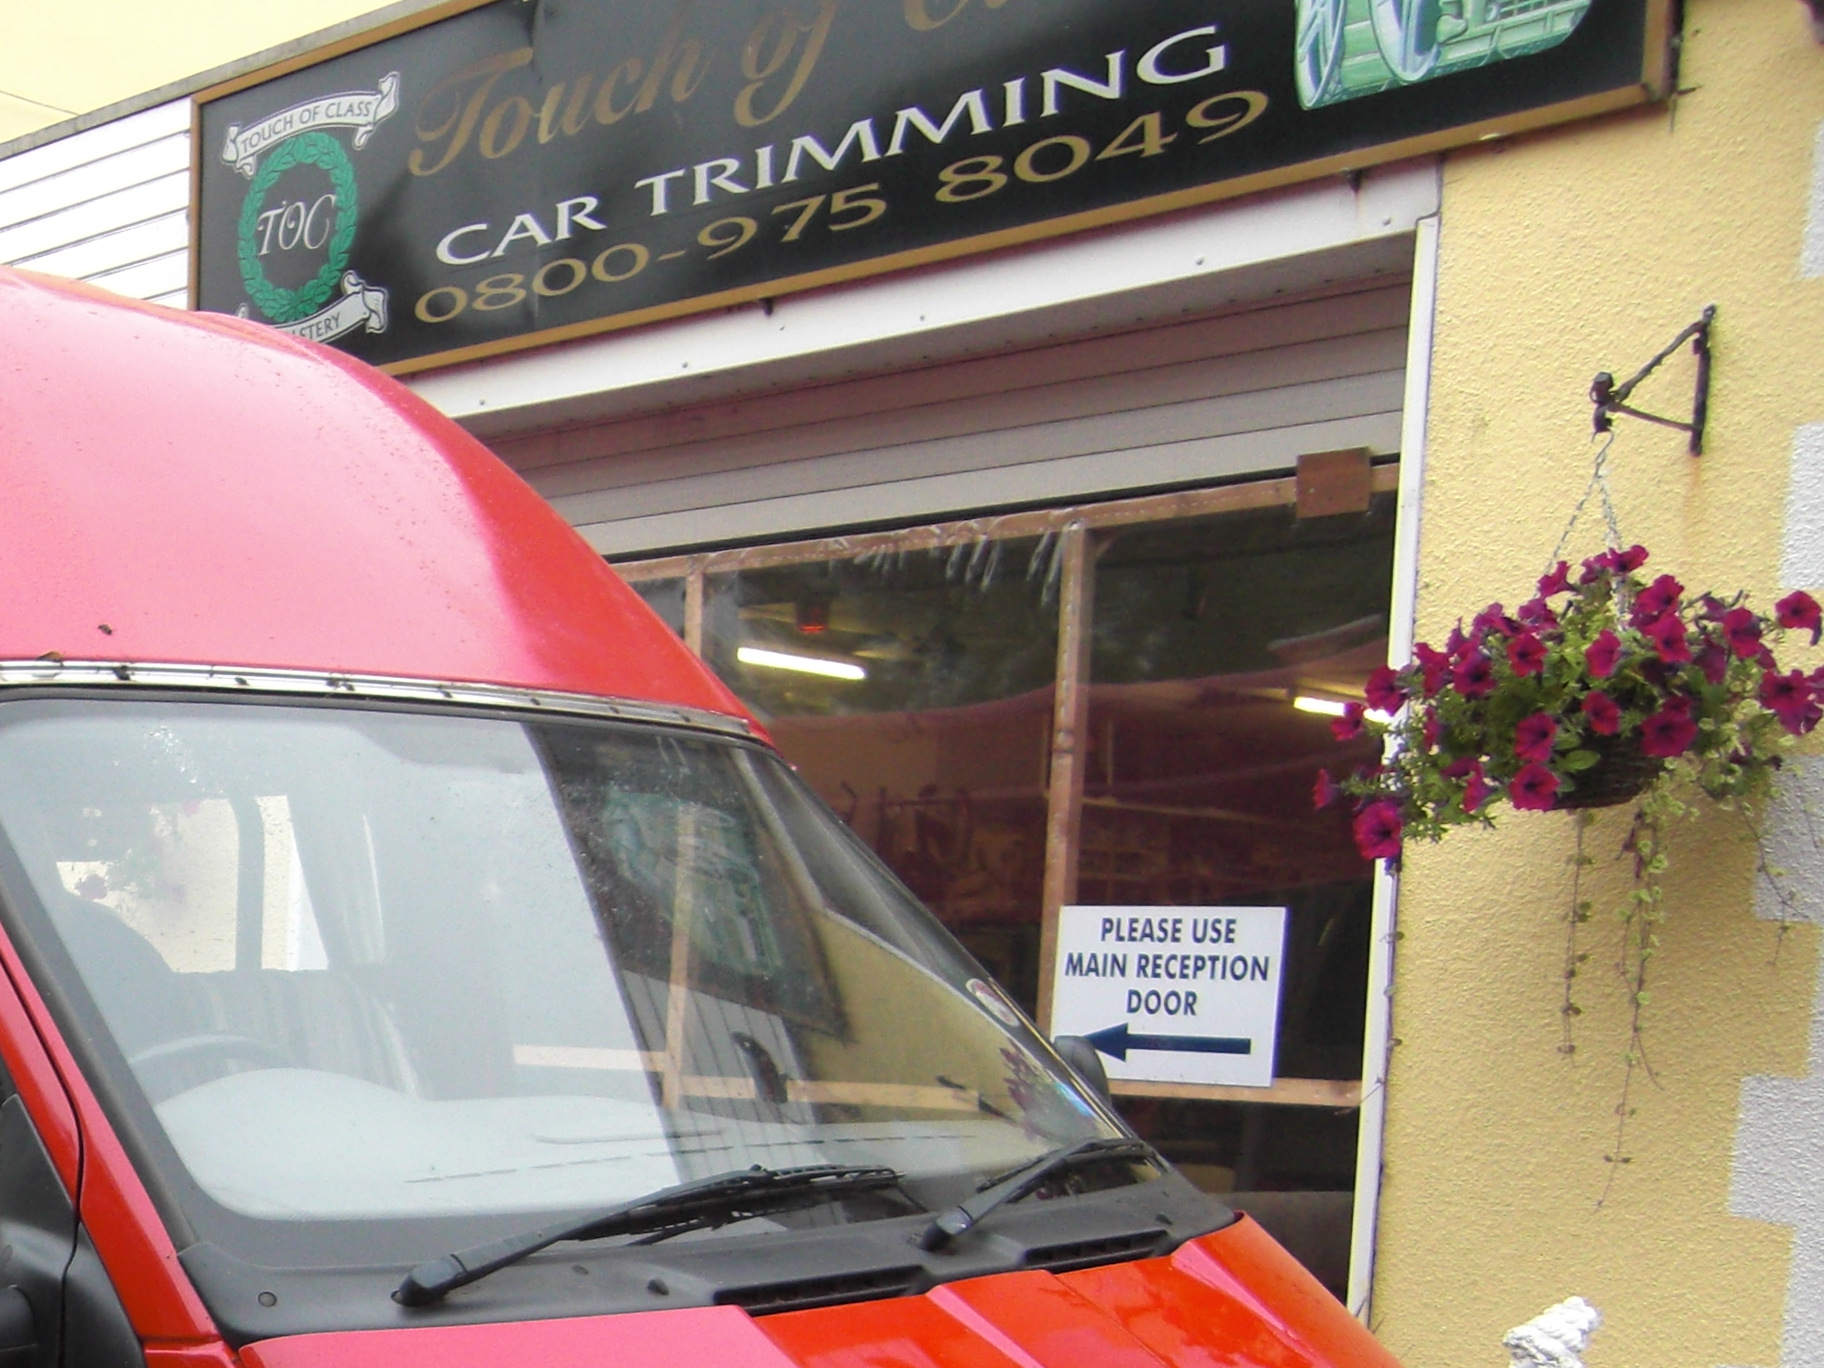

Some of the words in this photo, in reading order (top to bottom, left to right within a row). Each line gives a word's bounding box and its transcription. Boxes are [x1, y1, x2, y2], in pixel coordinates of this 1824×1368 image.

[408, 2, 714, 177] Touch
[240, 118, 294, 153] TOUCH
[299, 105, 320, 125] OF
[326, 101, 373, 120] CLASS
[436, 195, 607, 266] CAR
[635, 24, 1230, 217] TRIMMING
[257, 194, 337, 256] TOC
[414, 182, 887, 324] 0800-975
[936, 89, 1269, 203] 8049
[1100, 917, 1182, 943] PLEASE
[1192, 918, 1237, 944] USE
[1064, 952, 1127, 978] MAIN
[1136, 954, 1270, 981] RECEPTION
[1126, 989, 1197, 1016] DOOR
